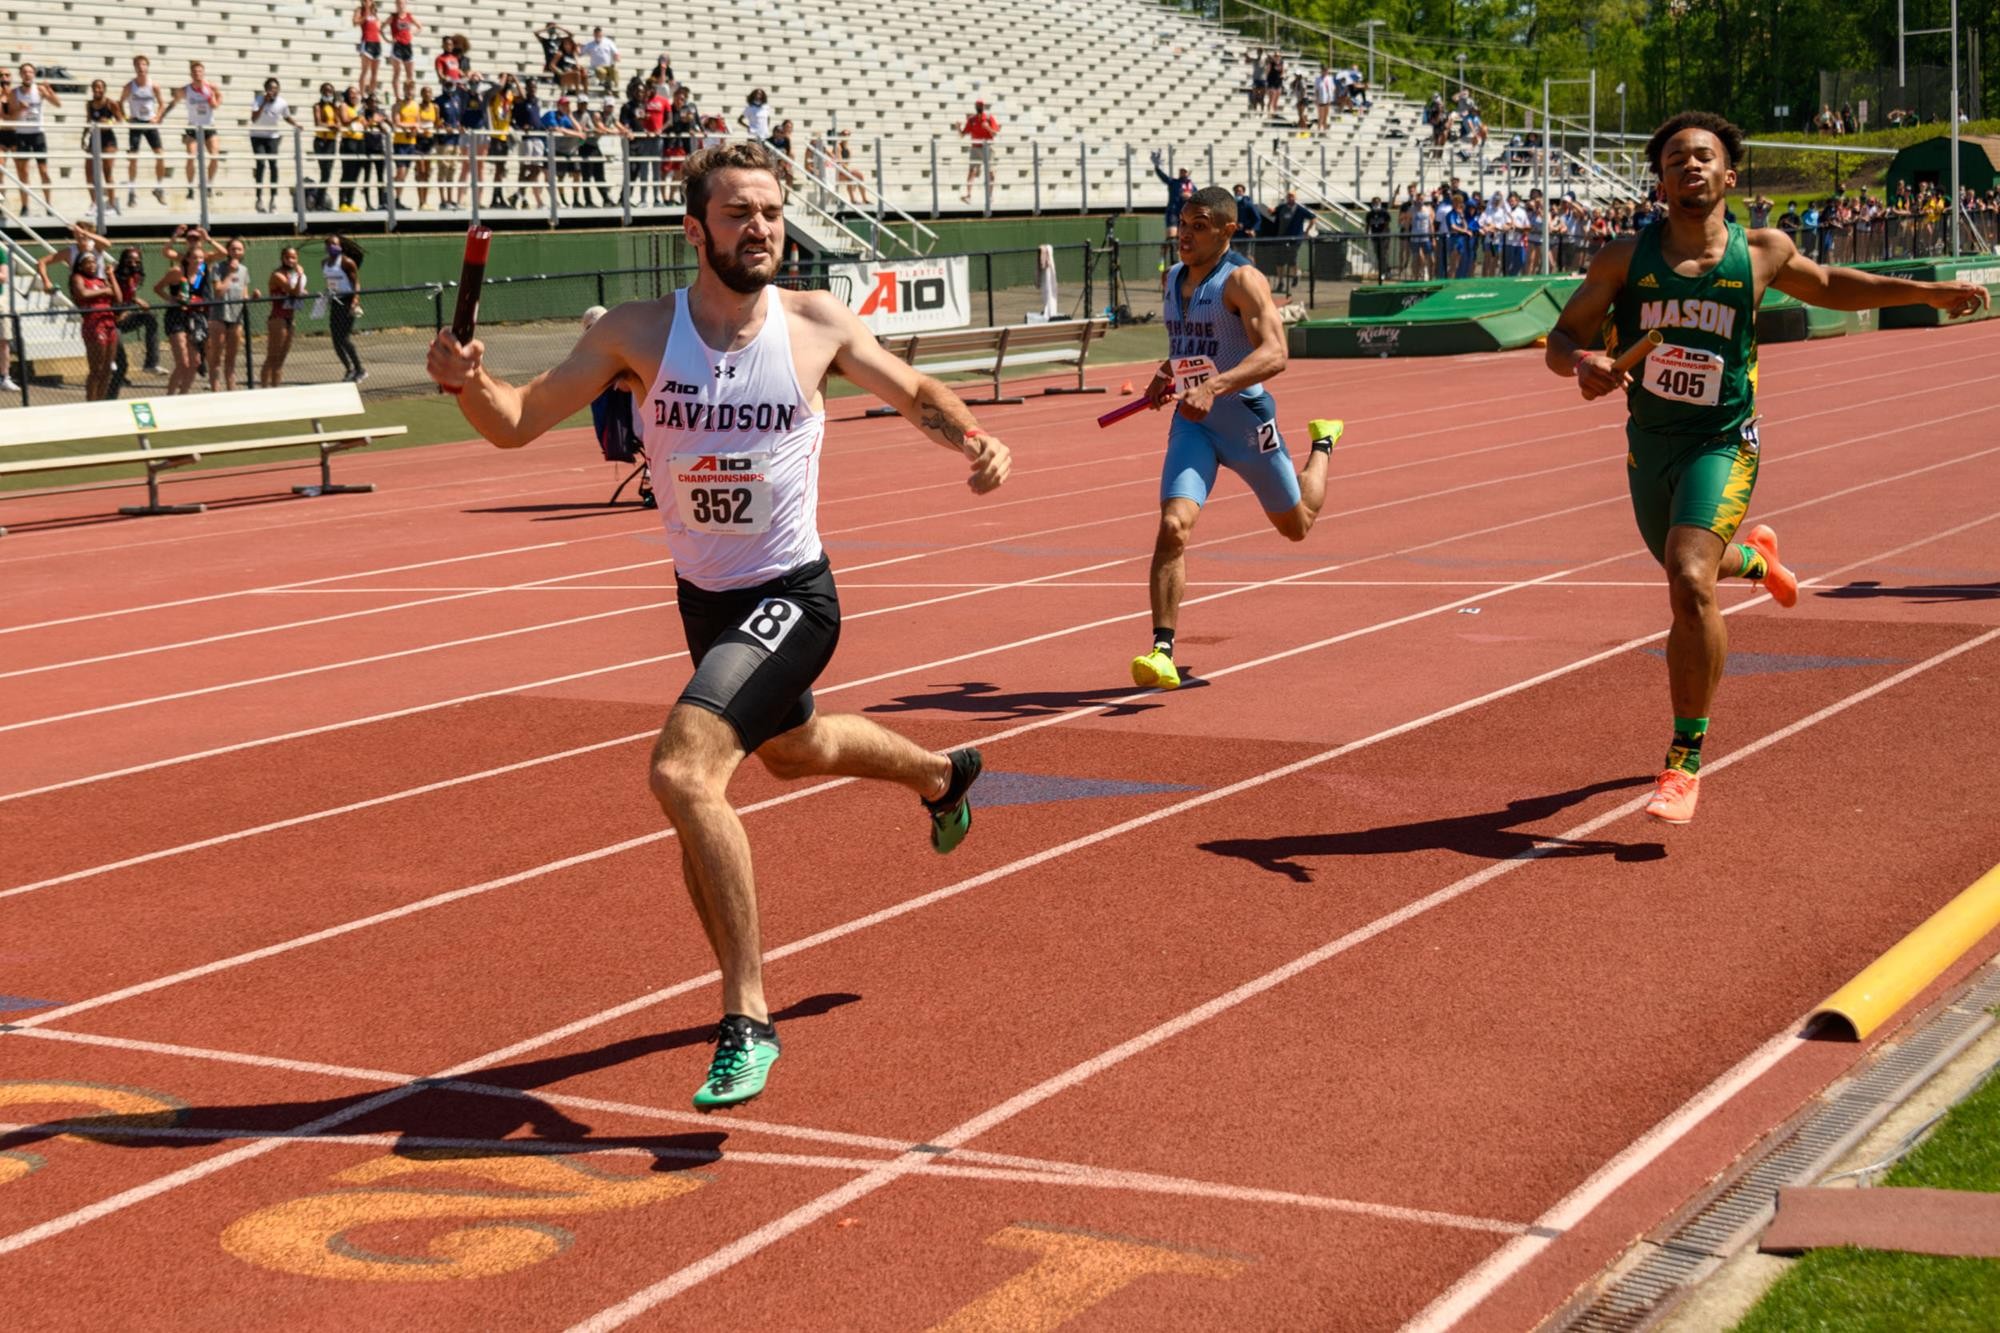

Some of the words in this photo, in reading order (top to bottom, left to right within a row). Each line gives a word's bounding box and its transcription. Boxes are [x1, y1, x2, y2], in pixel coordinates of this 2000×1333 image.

[858, 271, 945, 315] A10
[1713, 279, 1744, 288] A10
[1640, 299, 1736, 340] MASON
[1178, 359, 1204, 369] A10
[1662, 347, 1709, 362] A10
[660, 380, 699, 395] A10
[1656, 369, 1706, 398] 405
[654, 400, 796, 432] DAVIDSON
[1260, 424, 1277, 450] 2
[690, 456, 752, 471] A10
[678, 473, 764, 483] CHAMPIONSHIPS
[691, 488, 753, 524] 352
[749, 600, 791, 640] 8
